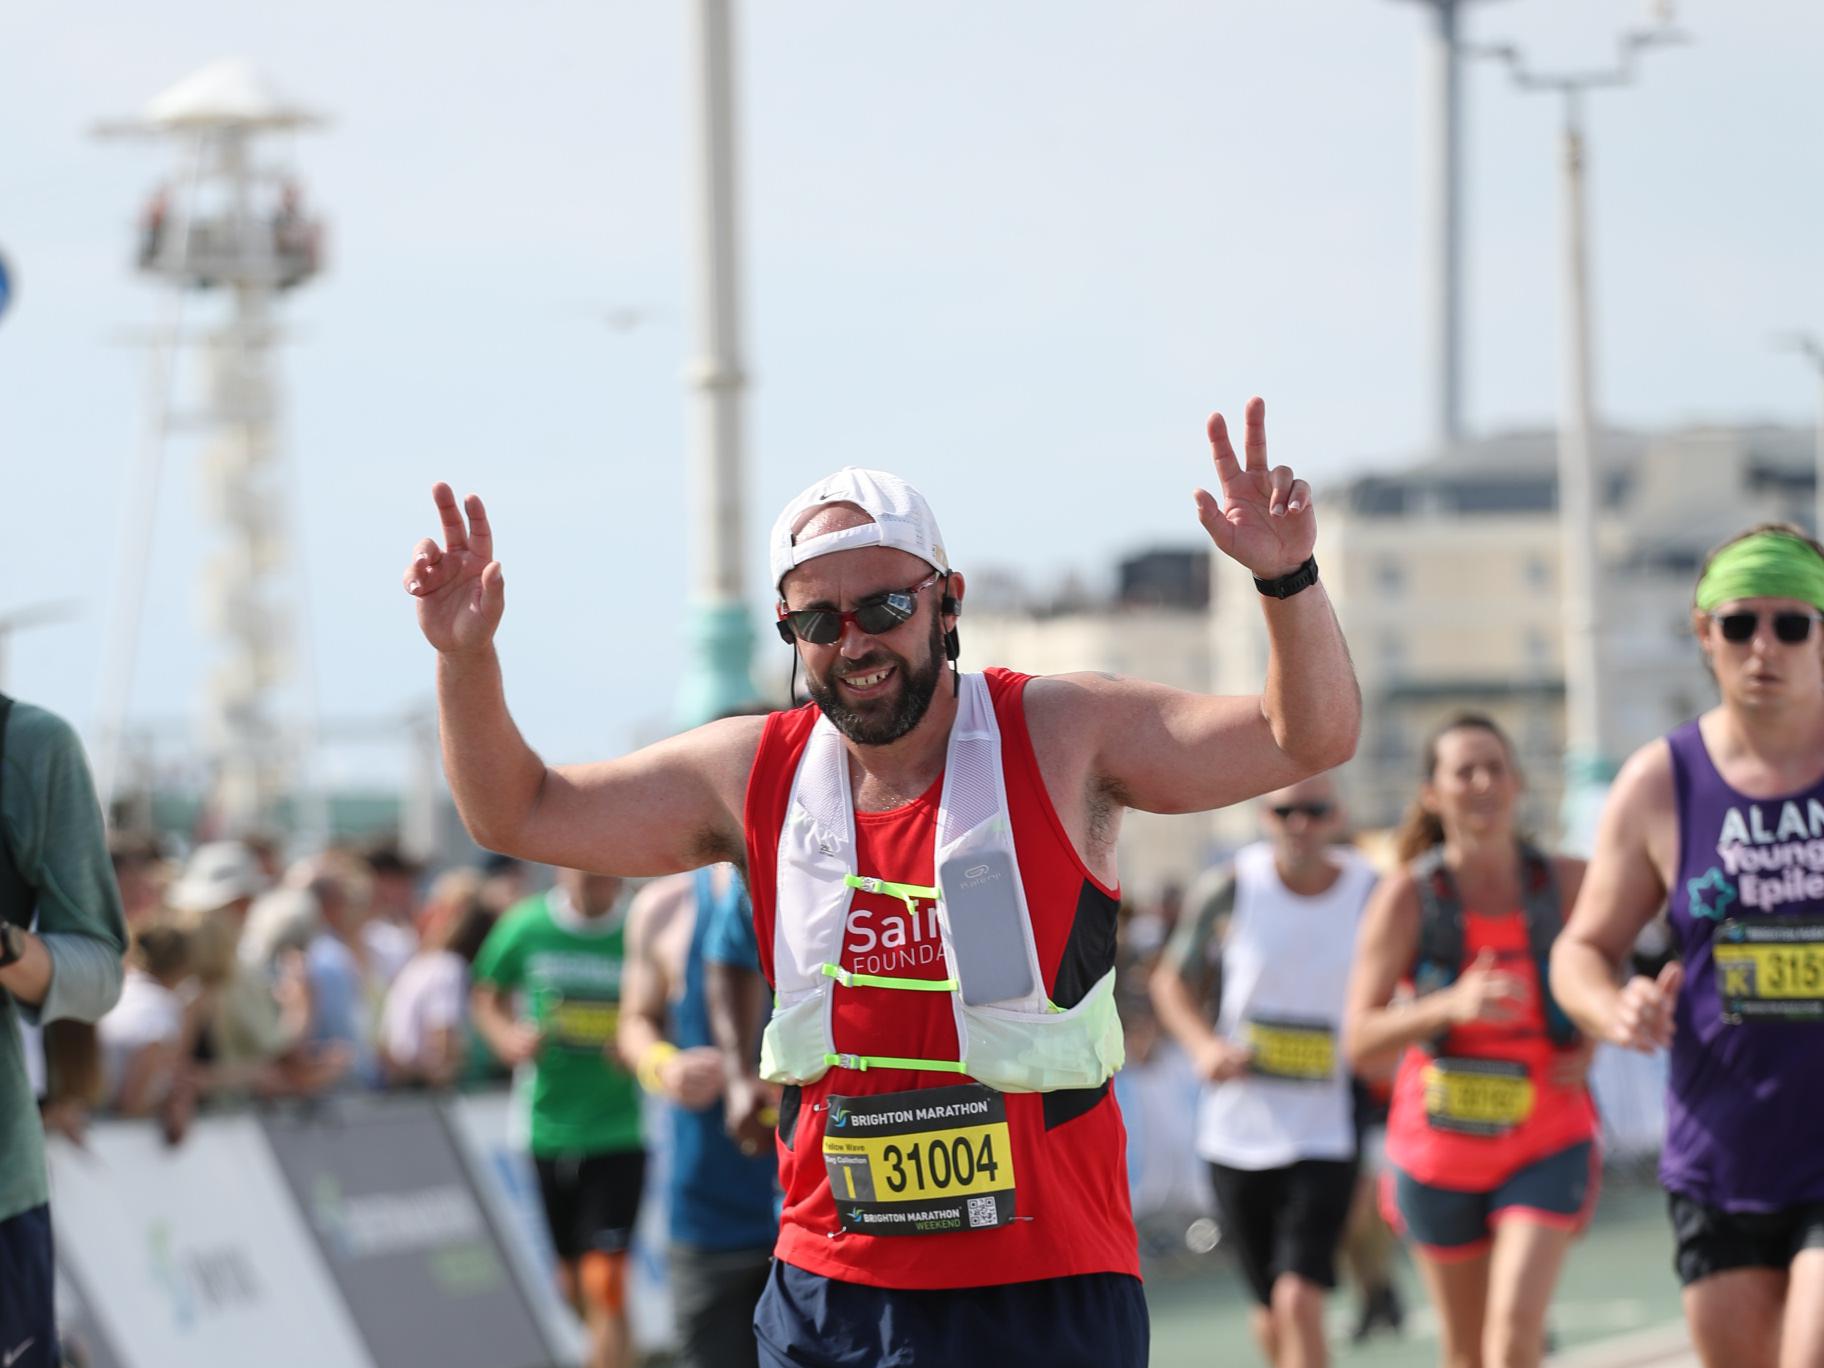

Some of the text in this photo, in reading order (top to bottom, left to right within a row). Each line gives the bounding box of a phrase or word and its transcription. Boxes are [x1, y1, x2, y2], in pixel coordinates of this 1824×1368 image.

[850, 1101, 988, 1127] BRIGHTON MARATHON
[883, 1133, 998, 1193] 31004
[863, 1209, 960, 1223] BRIGHTON MARATHON
[915, 1219, 961, 1231] WEEKEND
